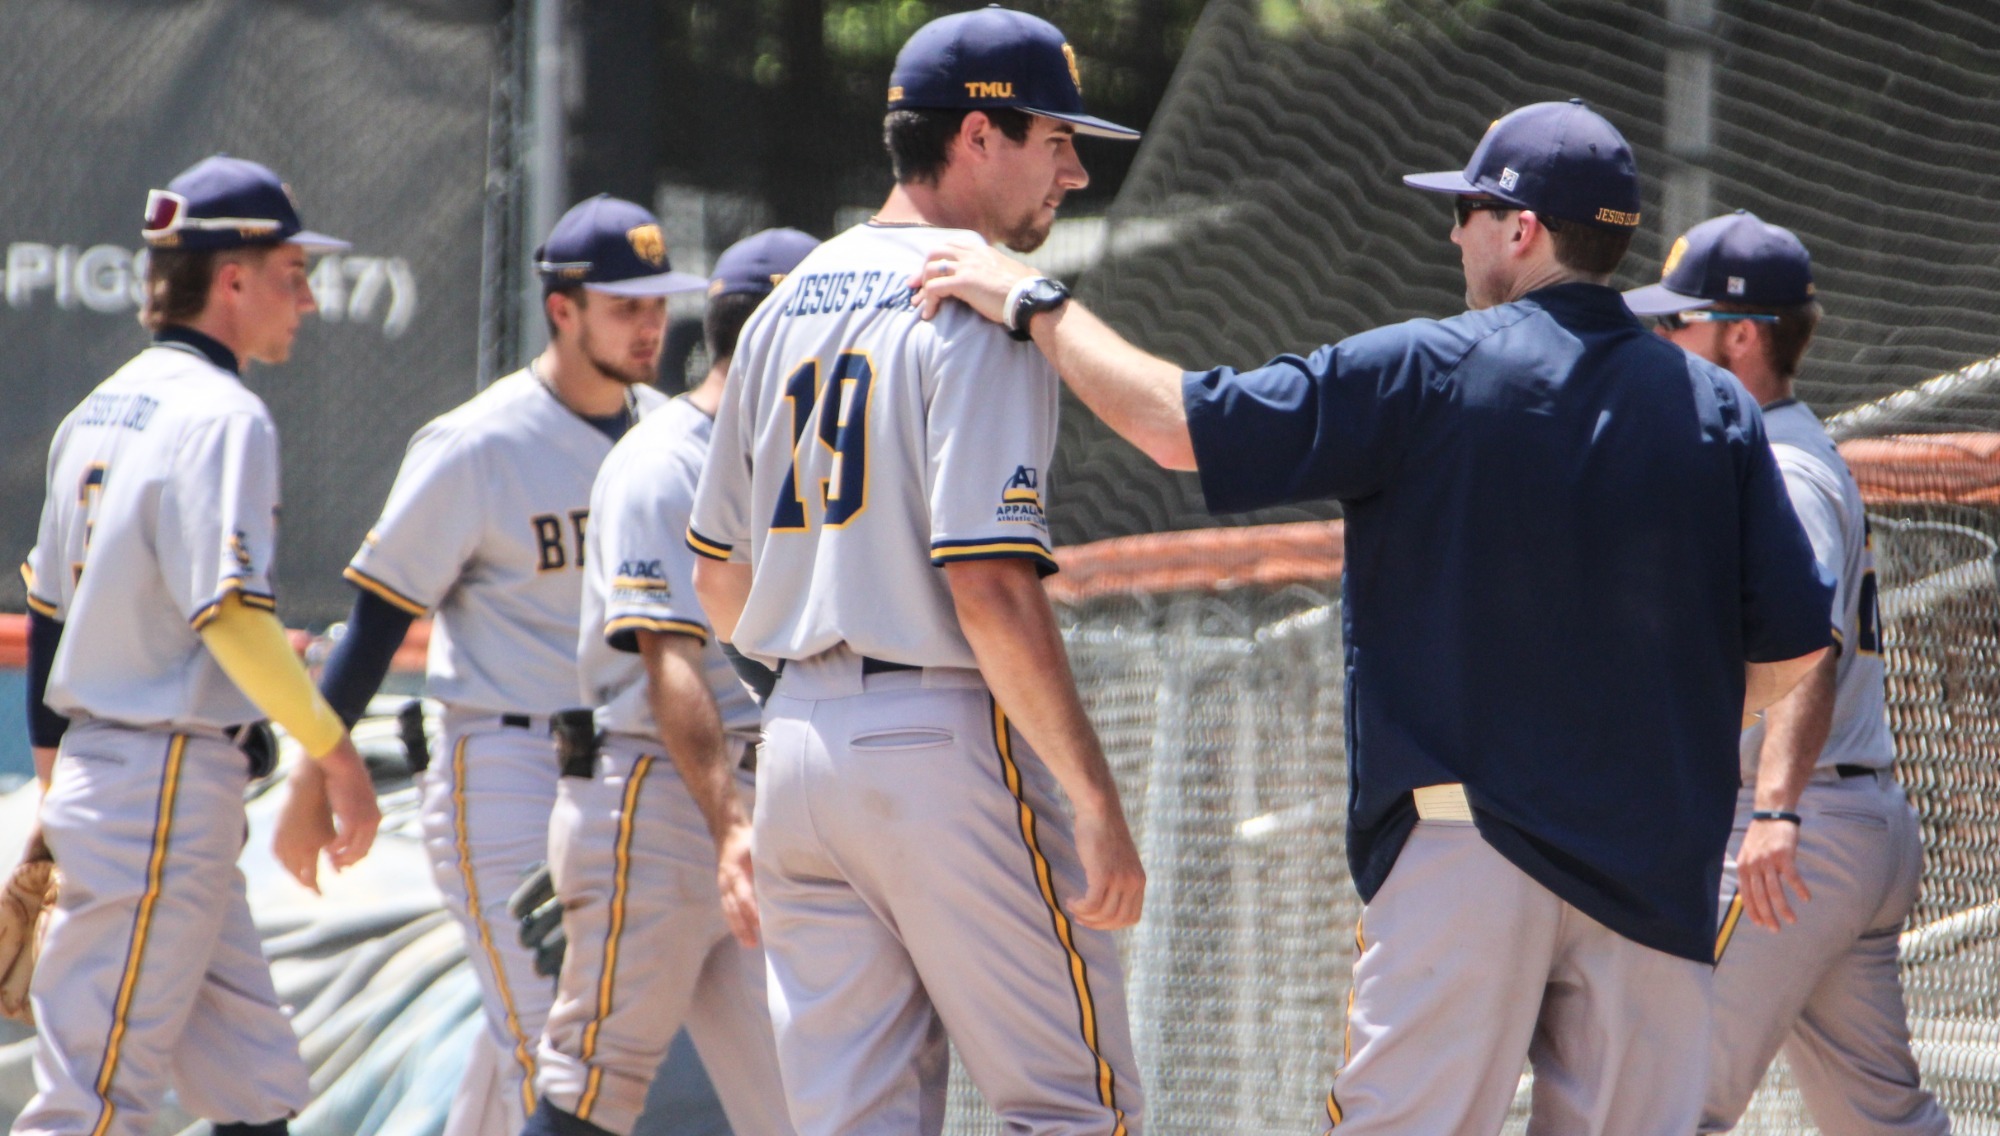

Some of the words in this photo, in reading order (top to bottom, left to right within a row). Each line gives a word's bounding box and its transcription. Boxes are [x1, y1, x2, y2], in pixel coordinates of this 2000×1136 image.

[963, 82, 1013, 99] TMU
[1595, 207, 1625, 225] JESUS
[307, 254, 418, 339] 47)
[784, 271, 856, 316] JESUS
[766, 348, 877, 534] 19
[996, 504, 1038, 516] APPAL
[530, 507, 590, 574] BE
[617, 559, 662, 580] AAC
